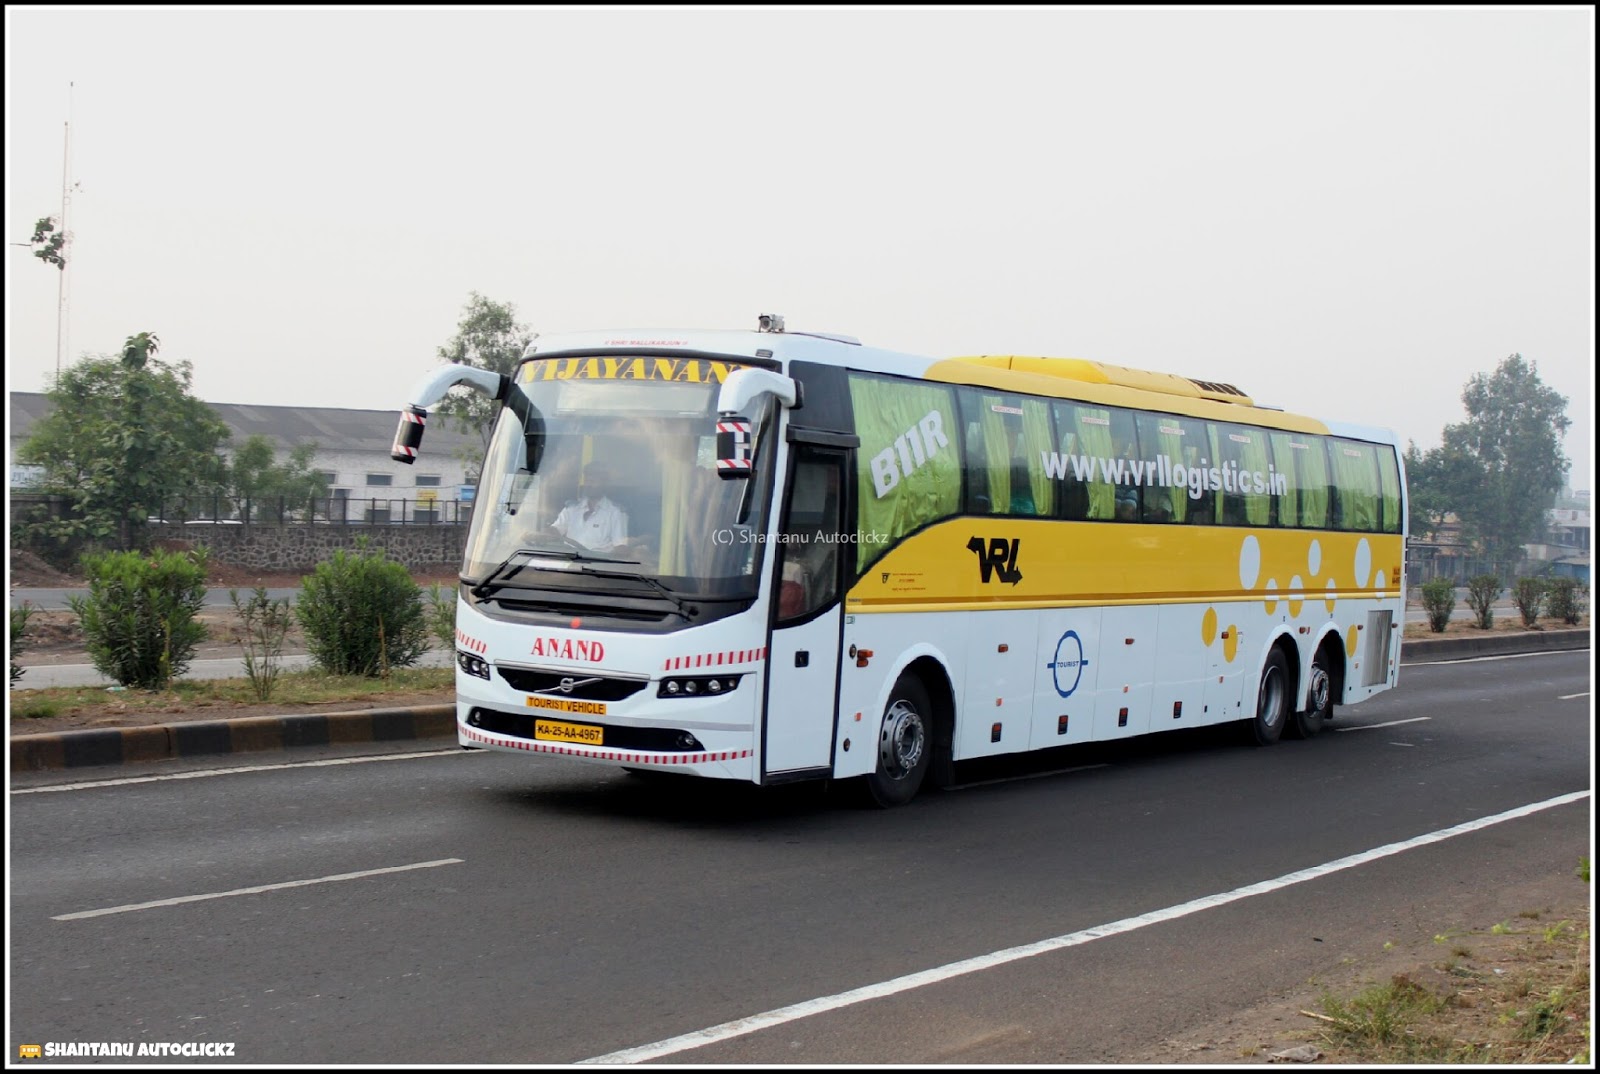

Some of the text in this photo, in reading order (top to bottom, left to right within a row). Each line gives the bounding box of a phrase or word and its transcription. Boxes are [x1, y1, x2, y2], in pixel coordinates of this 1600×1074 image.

[523, 357, 752, 384] VIJAYANAN
[870, 410, 949, 499] B11R
[1041, 451, 1287, 499] www.vrllogistics.in
[966, 536, 1023, 587] VRL
[531, 638, 605, 662] ANAND
[529, 697, 604, 715] TOURIST VEHICLE
[537, 725, 600, 740] KA-25-AA-4967
